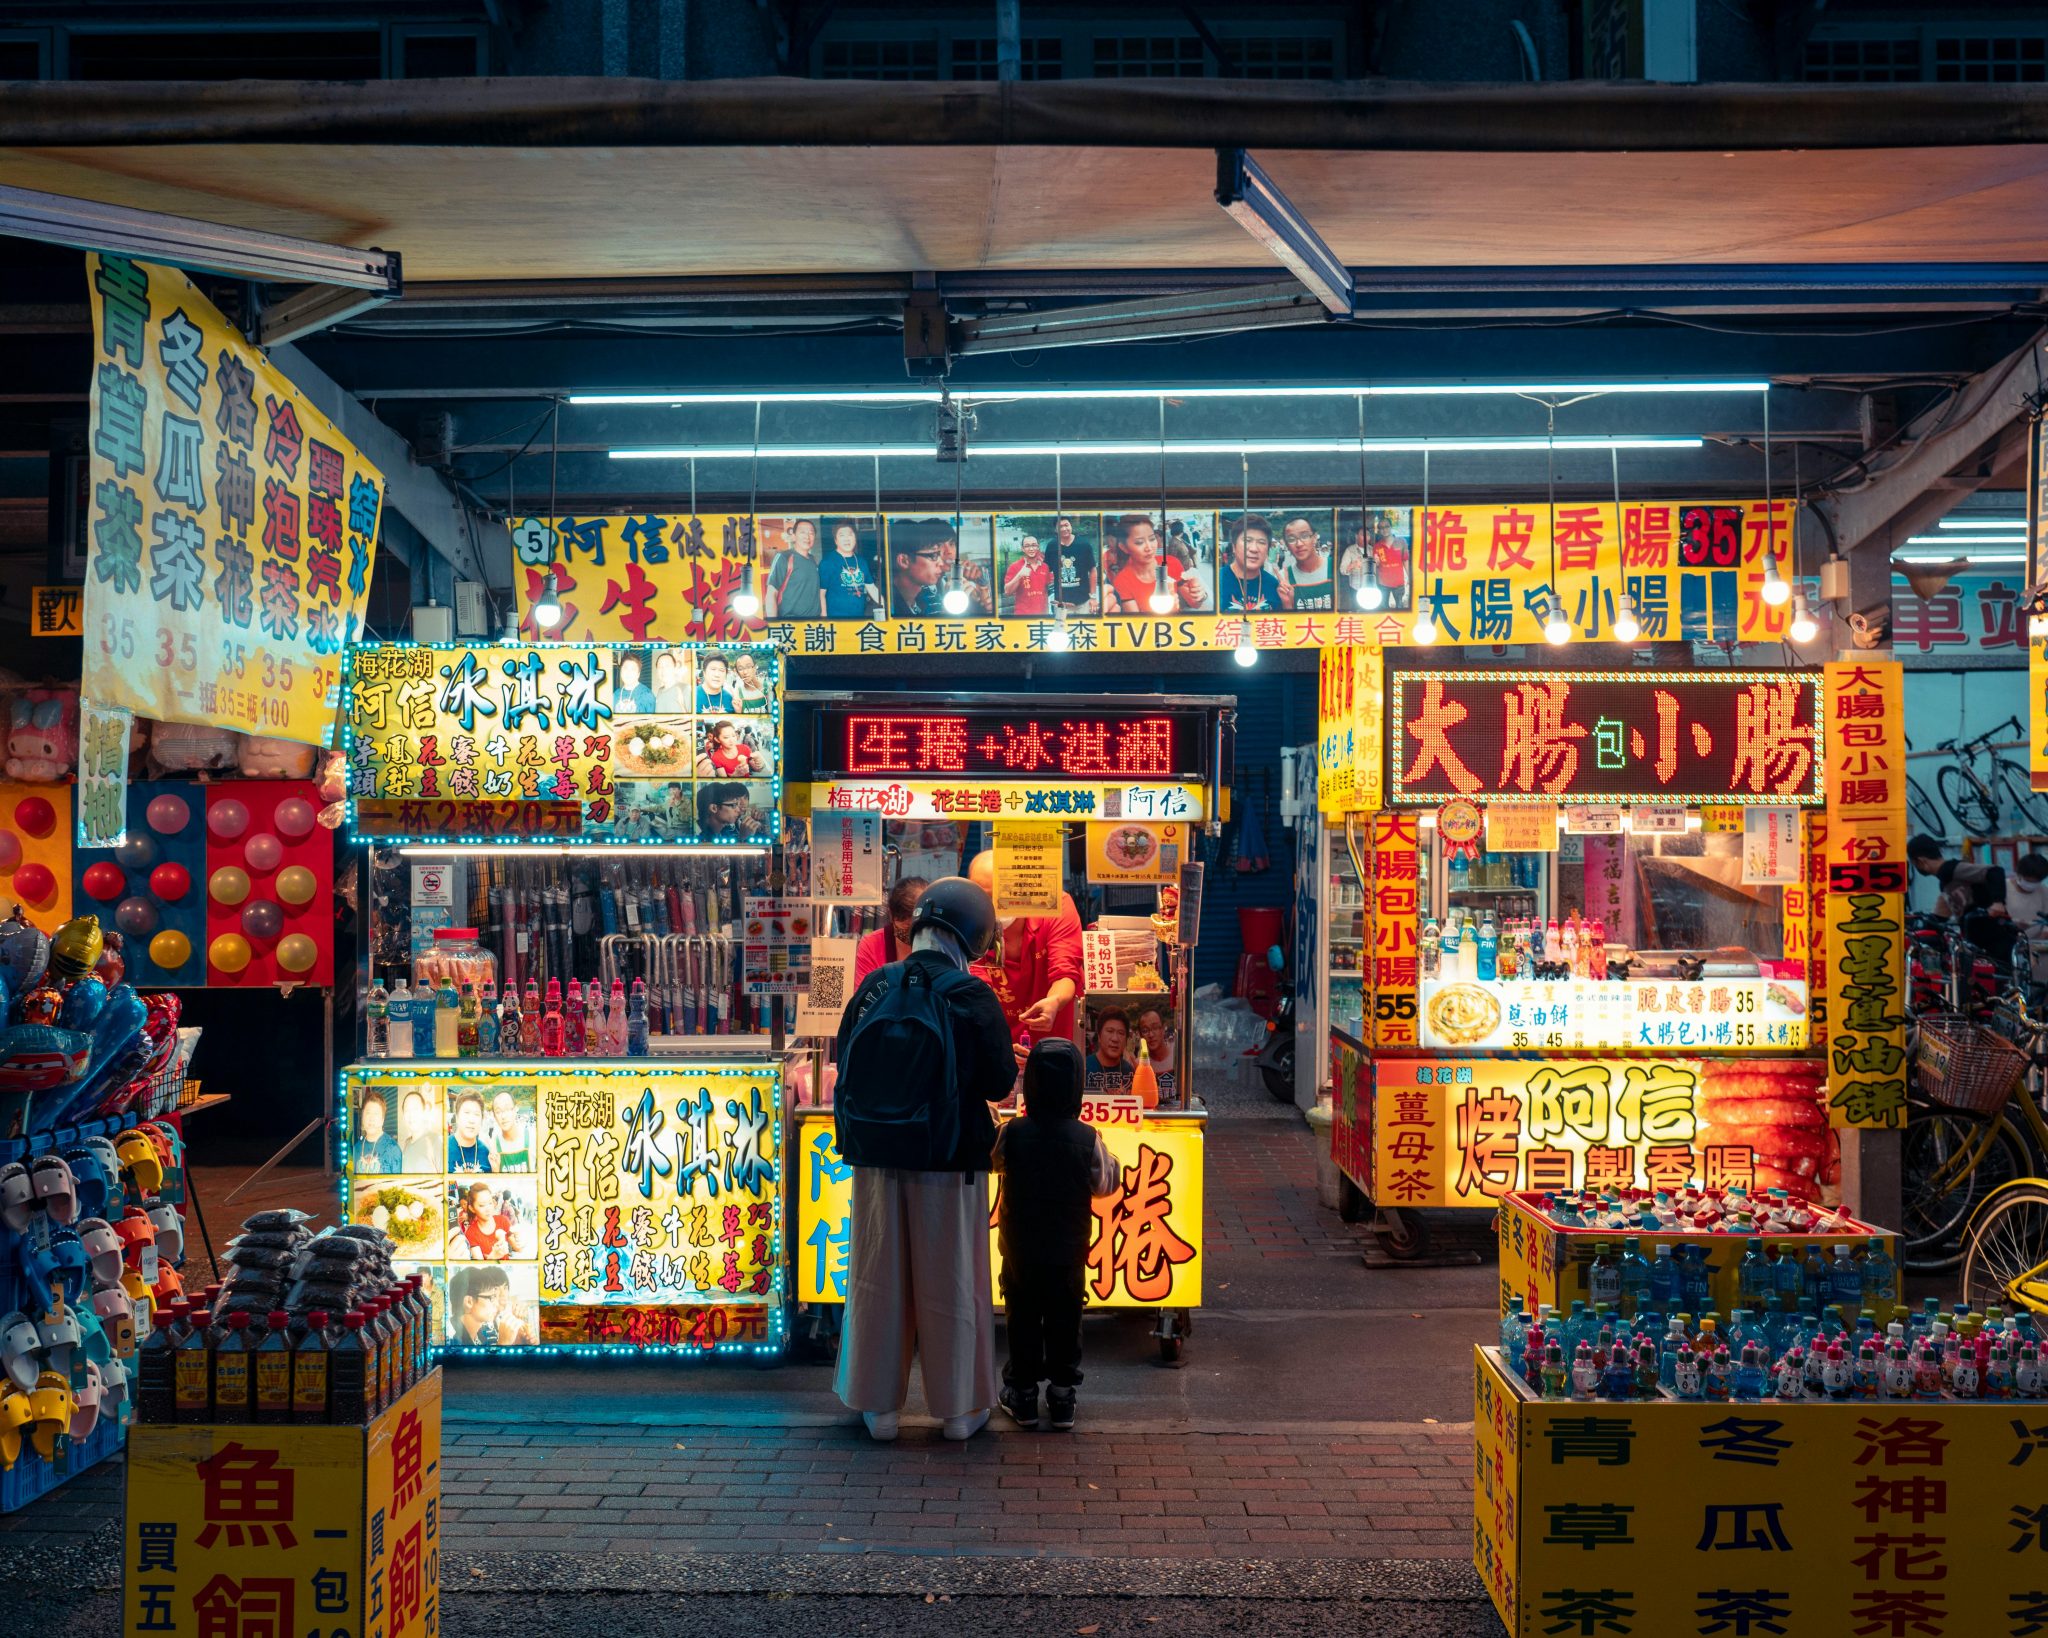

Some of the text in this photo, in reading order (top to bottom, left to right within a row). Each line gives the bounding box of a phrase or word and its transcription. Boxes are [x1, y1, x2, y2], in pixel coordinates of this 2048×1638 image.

[94, 252, 150, 595] 青草茶
[150, 306, 207, 613] 冬瓜茶
[214, 348, 257, 629] 洛神花
[260, 393, 303, 641] 冷泡茶
[307, 437, 345, 655] 彈珠汽水
[527, 530, 543, 554] 5
[101, 612, 135, 660] 35
[154, 627, 199, 672] 35
[222, 639, 245, 681] 35
[261, 652, 294, 692] 35
[353, 650, 433, 679] 梅花湖
[766, 622, 838, 653] 感謝
[351, 679, 437, 730] 阿信
[440, 651, 613, 731] 冰淇淋
[352, 734, 378, 799] 芋頭
[383, 733, 414, 797] 鳳梨
[417, 734, 447, 798] 花豆
[483, 735, 513, 798] 牛奶
[516, 734, 546, 798] 花生
[550, 734, 579, 799] 草莓
[1400, 679, 1815, 795] 大腸包小腸
[583, 733, 614, 824] 巧克力
[827, 783, 1189, 817] 梅花湖 花生捲+冰淇淋 阿信
[1828, 665, 1905, 892] 大腸包小腸一份 55
[1563, 842, 1579, 857] 52
[1376, 814, 1417, 1043] 大腸包小腸55元
[1513, 1032, 1529, 1048] 35
[1546, 1032, 1563, 1048] 45
[1736, 991, 1754, 1013] 35
[1736, 1024, 1755, 1046] 55
[1790, 1025, 1800, 1047] 25
[544, 1091, 615, 1129] 梅花湖
[1088, 1071, 1176, 1091] 綜藝大合
[1525, 1064, 1698, 1143] 阿信
[543, 1132, 620, 1201] 阿信
[622, 1086, 775, 1198] 冰淇淋
[1386, 1091, 1437, 1202] 薑母茶
[1455, 1086, 1522, 1198] 烤
[1525, 1143, 1757, 1197] 自製香腸
[543, 1205, 569, 1295] 芋頭
[571, 1204, 601, 1292] 鳳梨
[602, 1205, 629, 1293] 花豆
[658, 1208, 687, 1292] 牛奶
[688, 1204, 716, 1292] 花生
[718, 1203, 746, 1295] 草莓
[747, 1201, 774, 1296] 巧克力
[1538, 1416, 1638, 1637] 青草茶
[1694, 1415, 1795, 1637] 冬瓜茶
[1849, 1416, 1952, 1637] 洛神花茶
[136, 1521, 178, 1632] 買五
[369, 1506, 386, 1638] 買五
